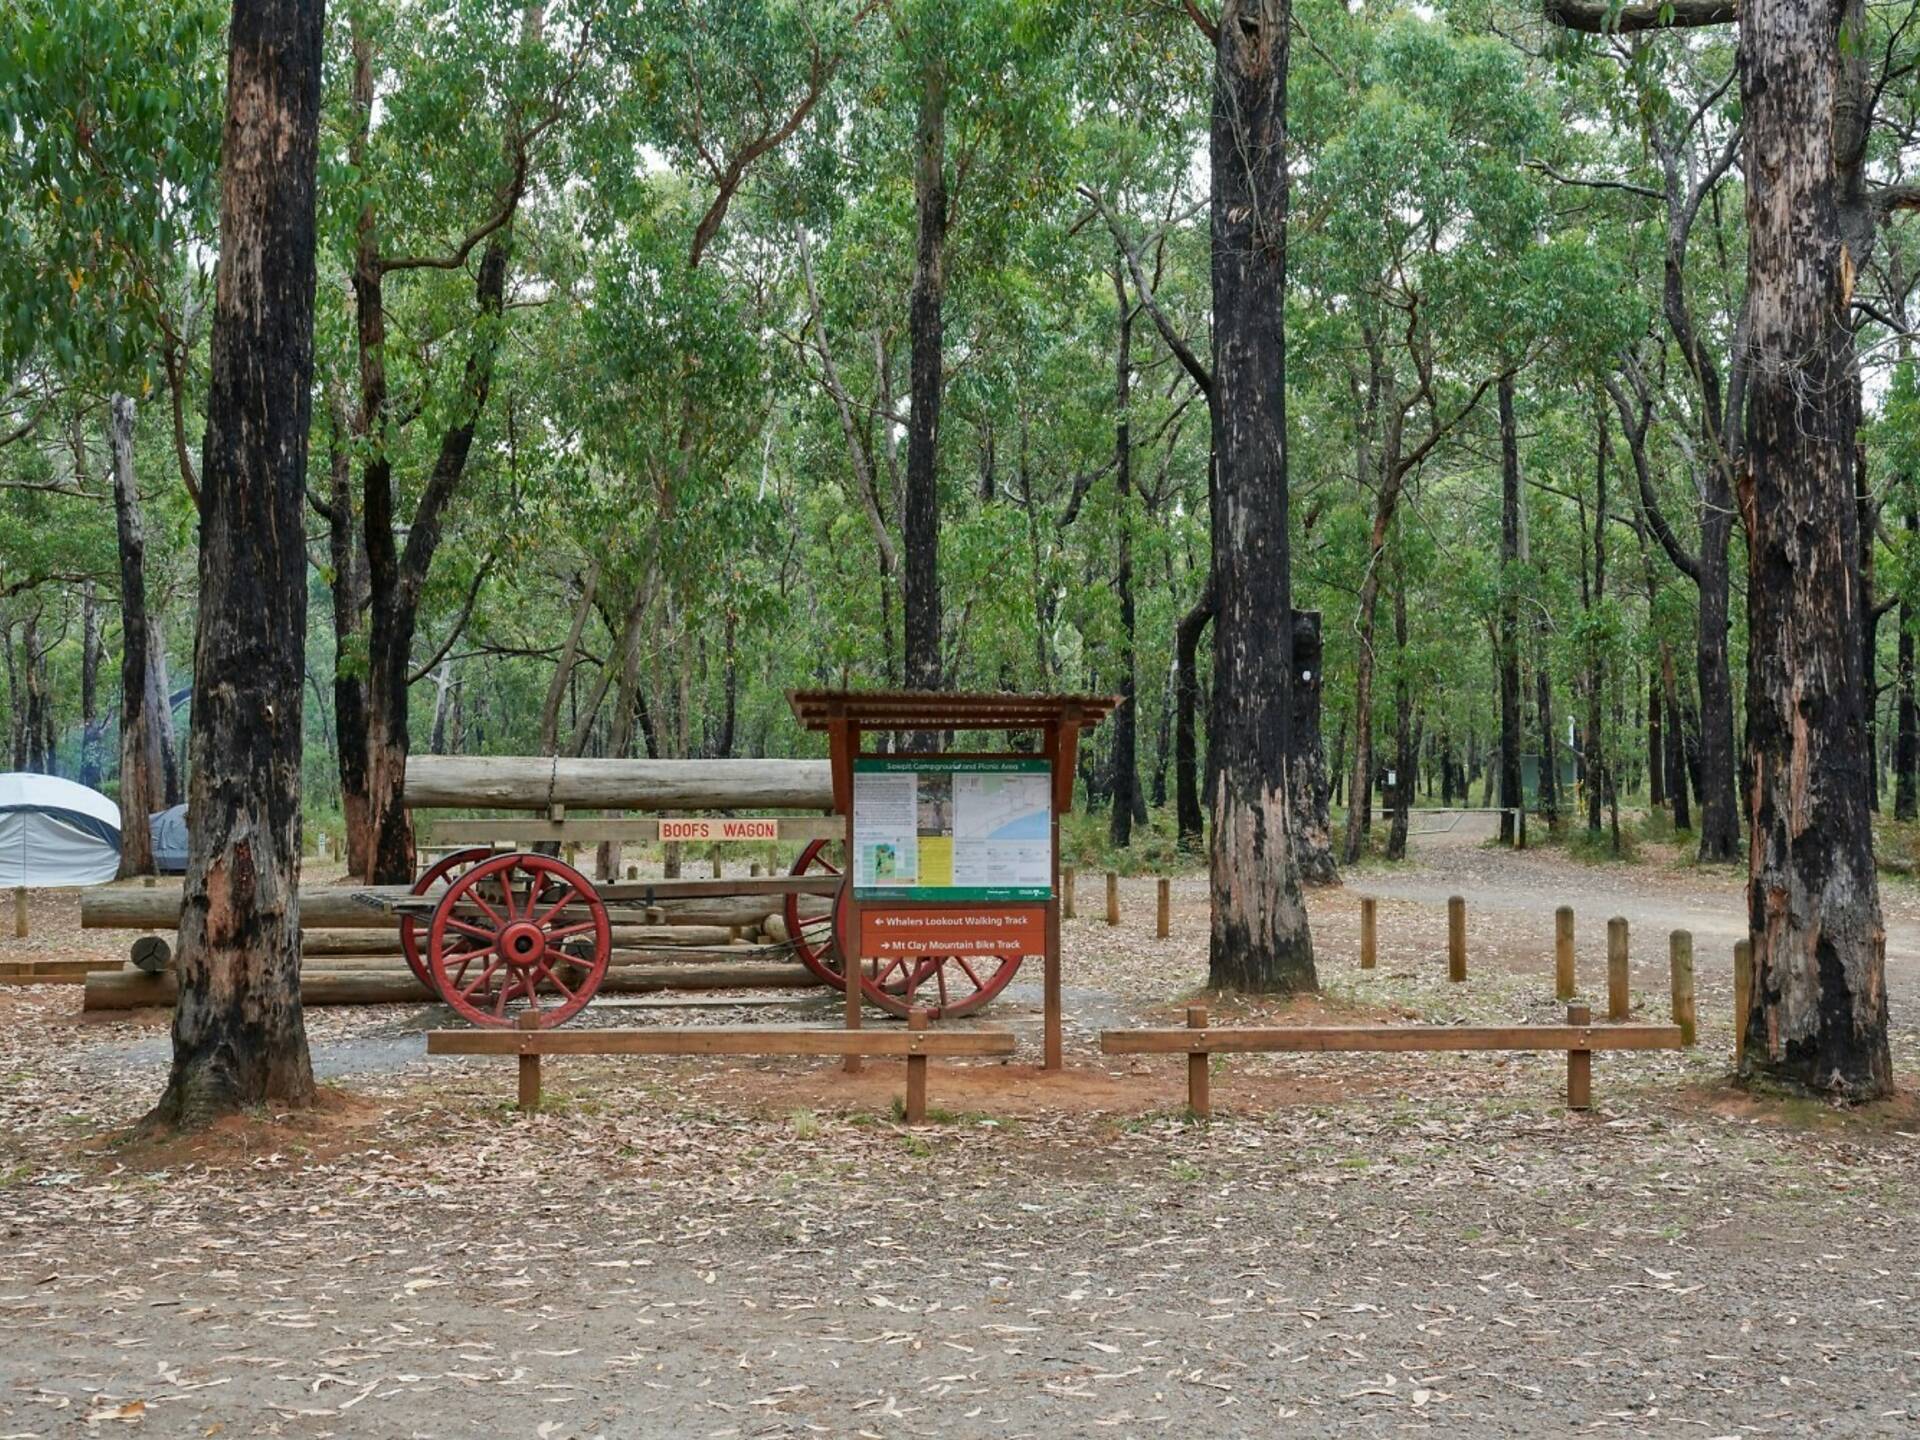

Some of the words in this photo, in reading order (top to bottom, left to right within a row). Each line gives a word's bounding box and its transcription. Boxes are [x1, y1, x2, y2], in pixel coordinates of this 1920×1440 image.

[663, 823, 710, 838] BOOFS
[723, 823, 775, 838] WAGON
[886, 916, 924, 926] Whalers
[926, 916, 963, 926] Lookout
[965, 915, 1003, 927] Walking
[1004, 915, 1029, 925] Track
[892, 941, 906, 950] Mt
[907, 940, 928, 952] Clay
[929, 940, 974, 950] Mountain
[975, 940, 996, 949] Bike
[997, 940, 1021, 949] Track
